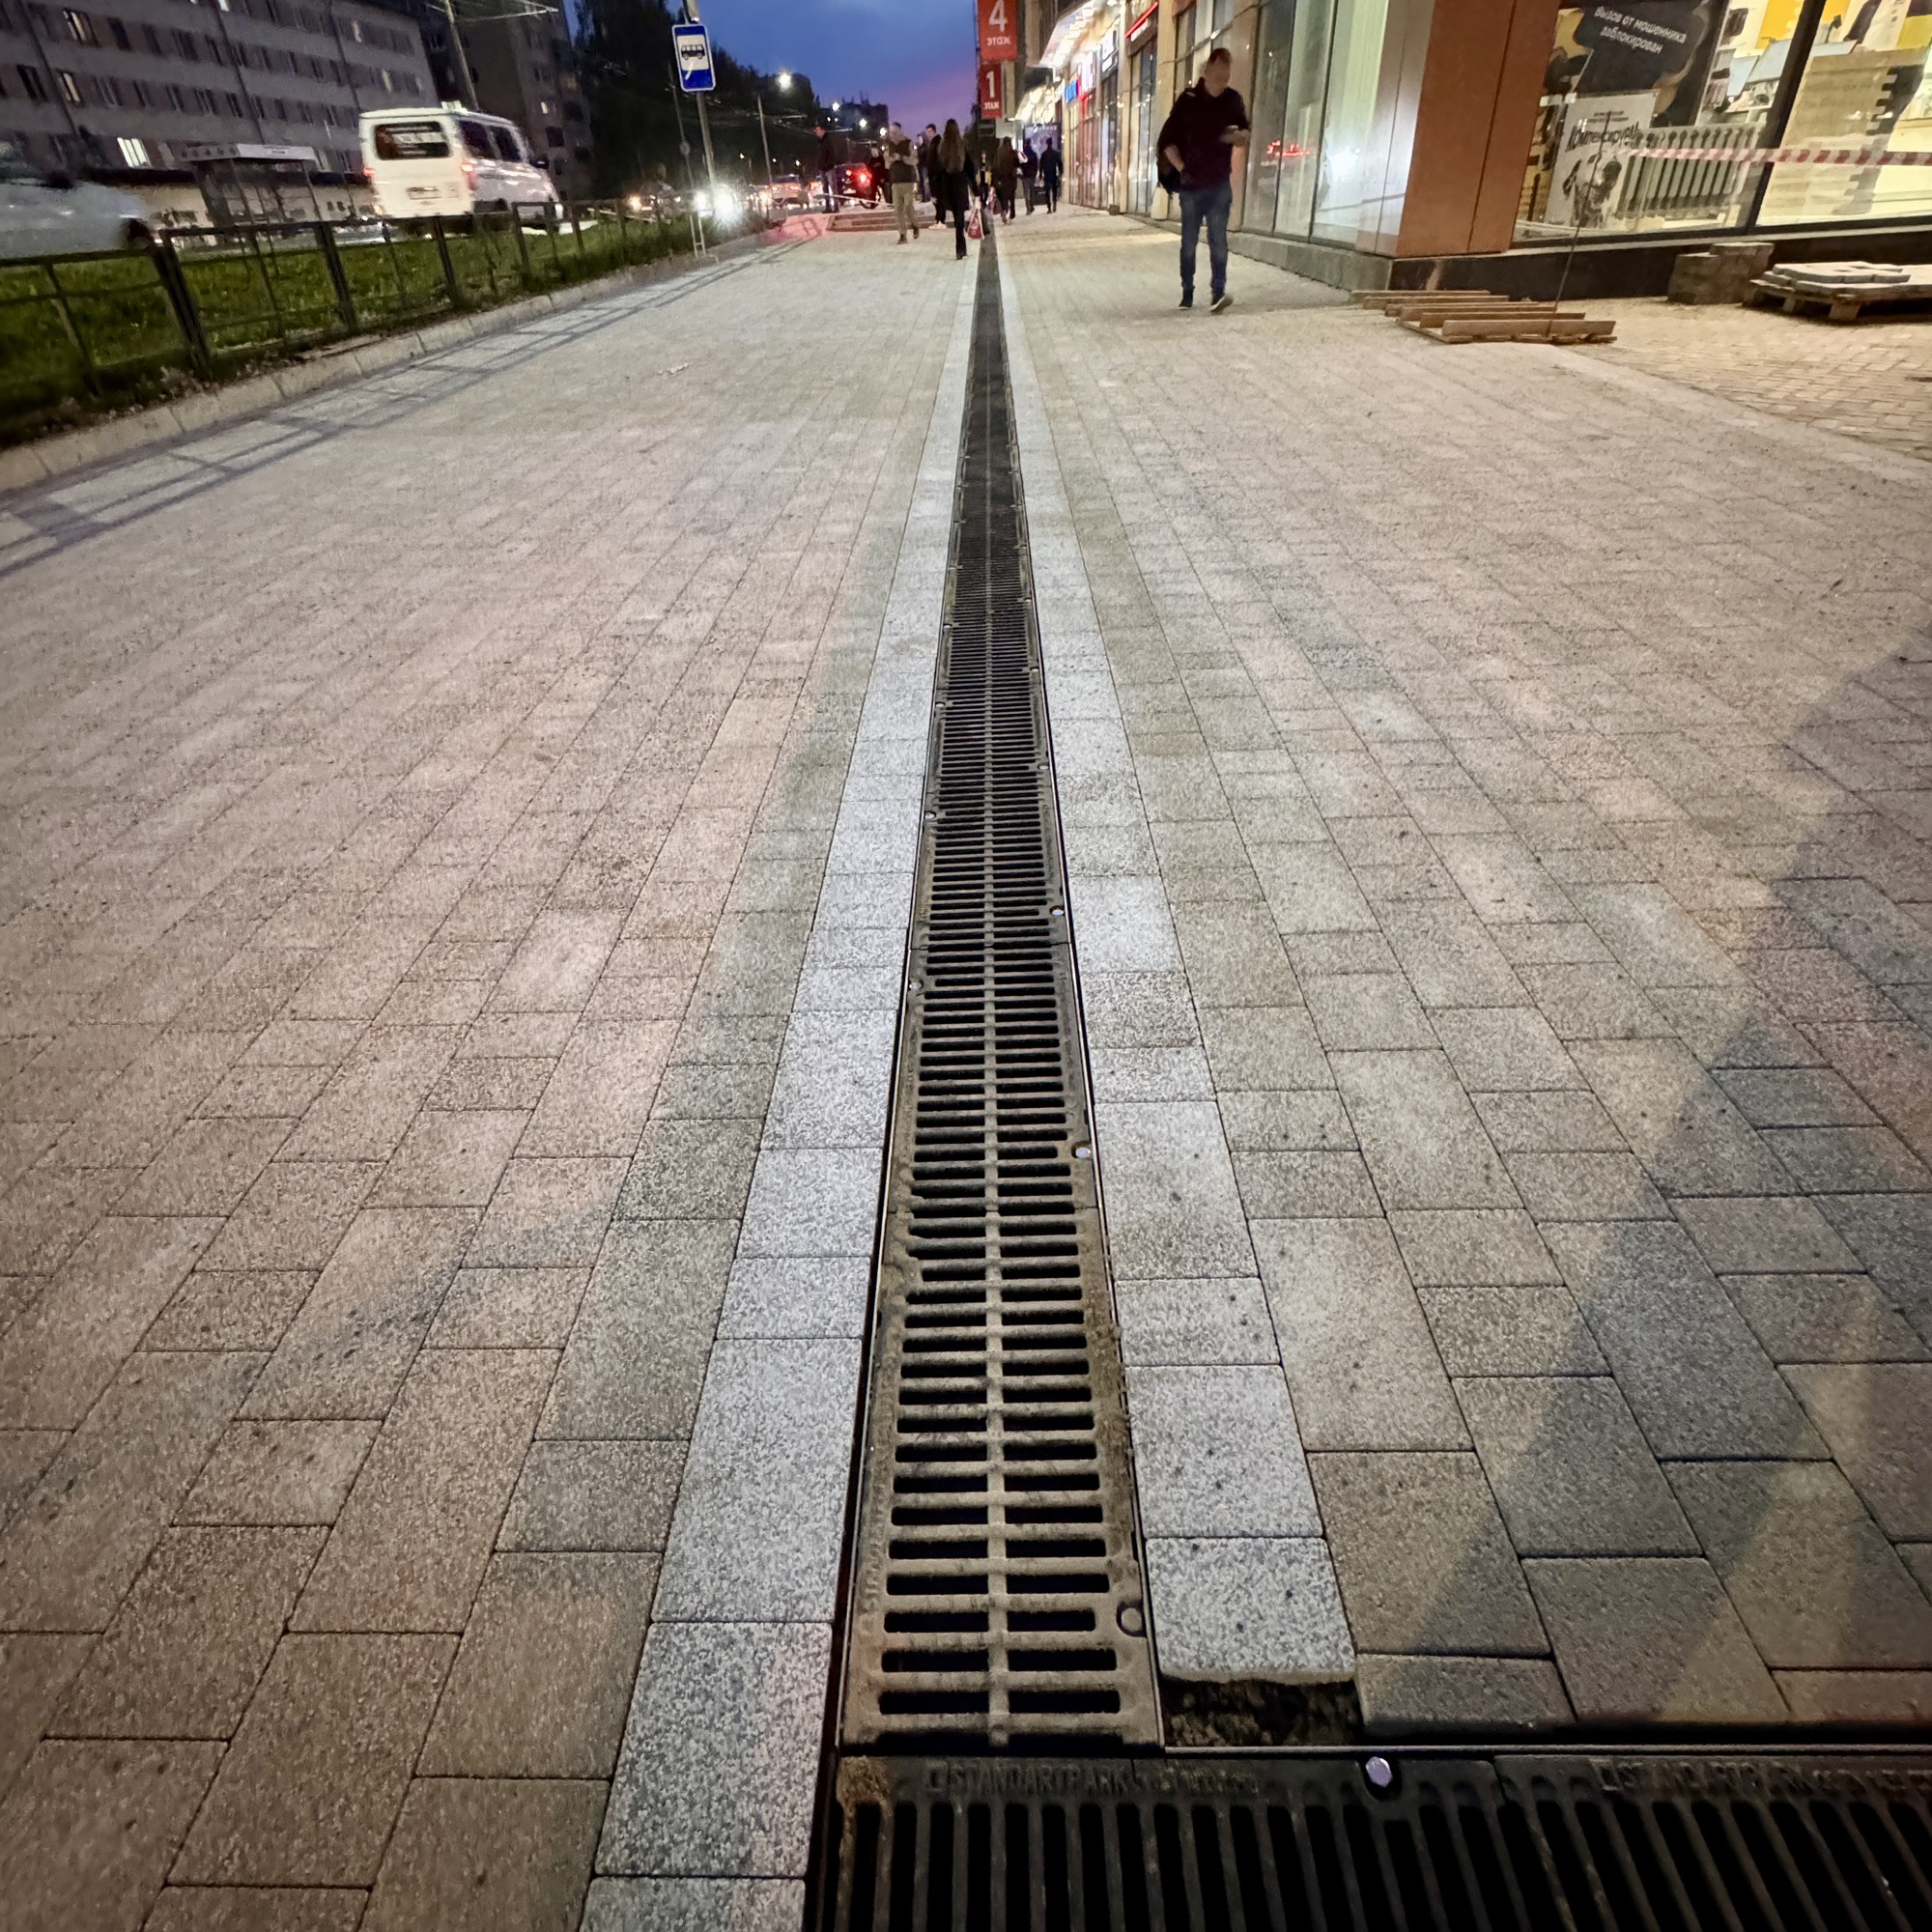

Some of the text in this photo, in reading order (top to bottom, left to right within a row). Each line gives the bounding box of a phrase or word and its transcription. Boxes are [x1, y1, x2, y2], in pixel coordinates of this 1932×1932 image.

[988, 0, 1009, 33] 4
[1594, 6, 1688, 44] Вызов от мошенника
[1600, 26, 1663, 54] заблокирован
[986, 71, 995, 99] 1
